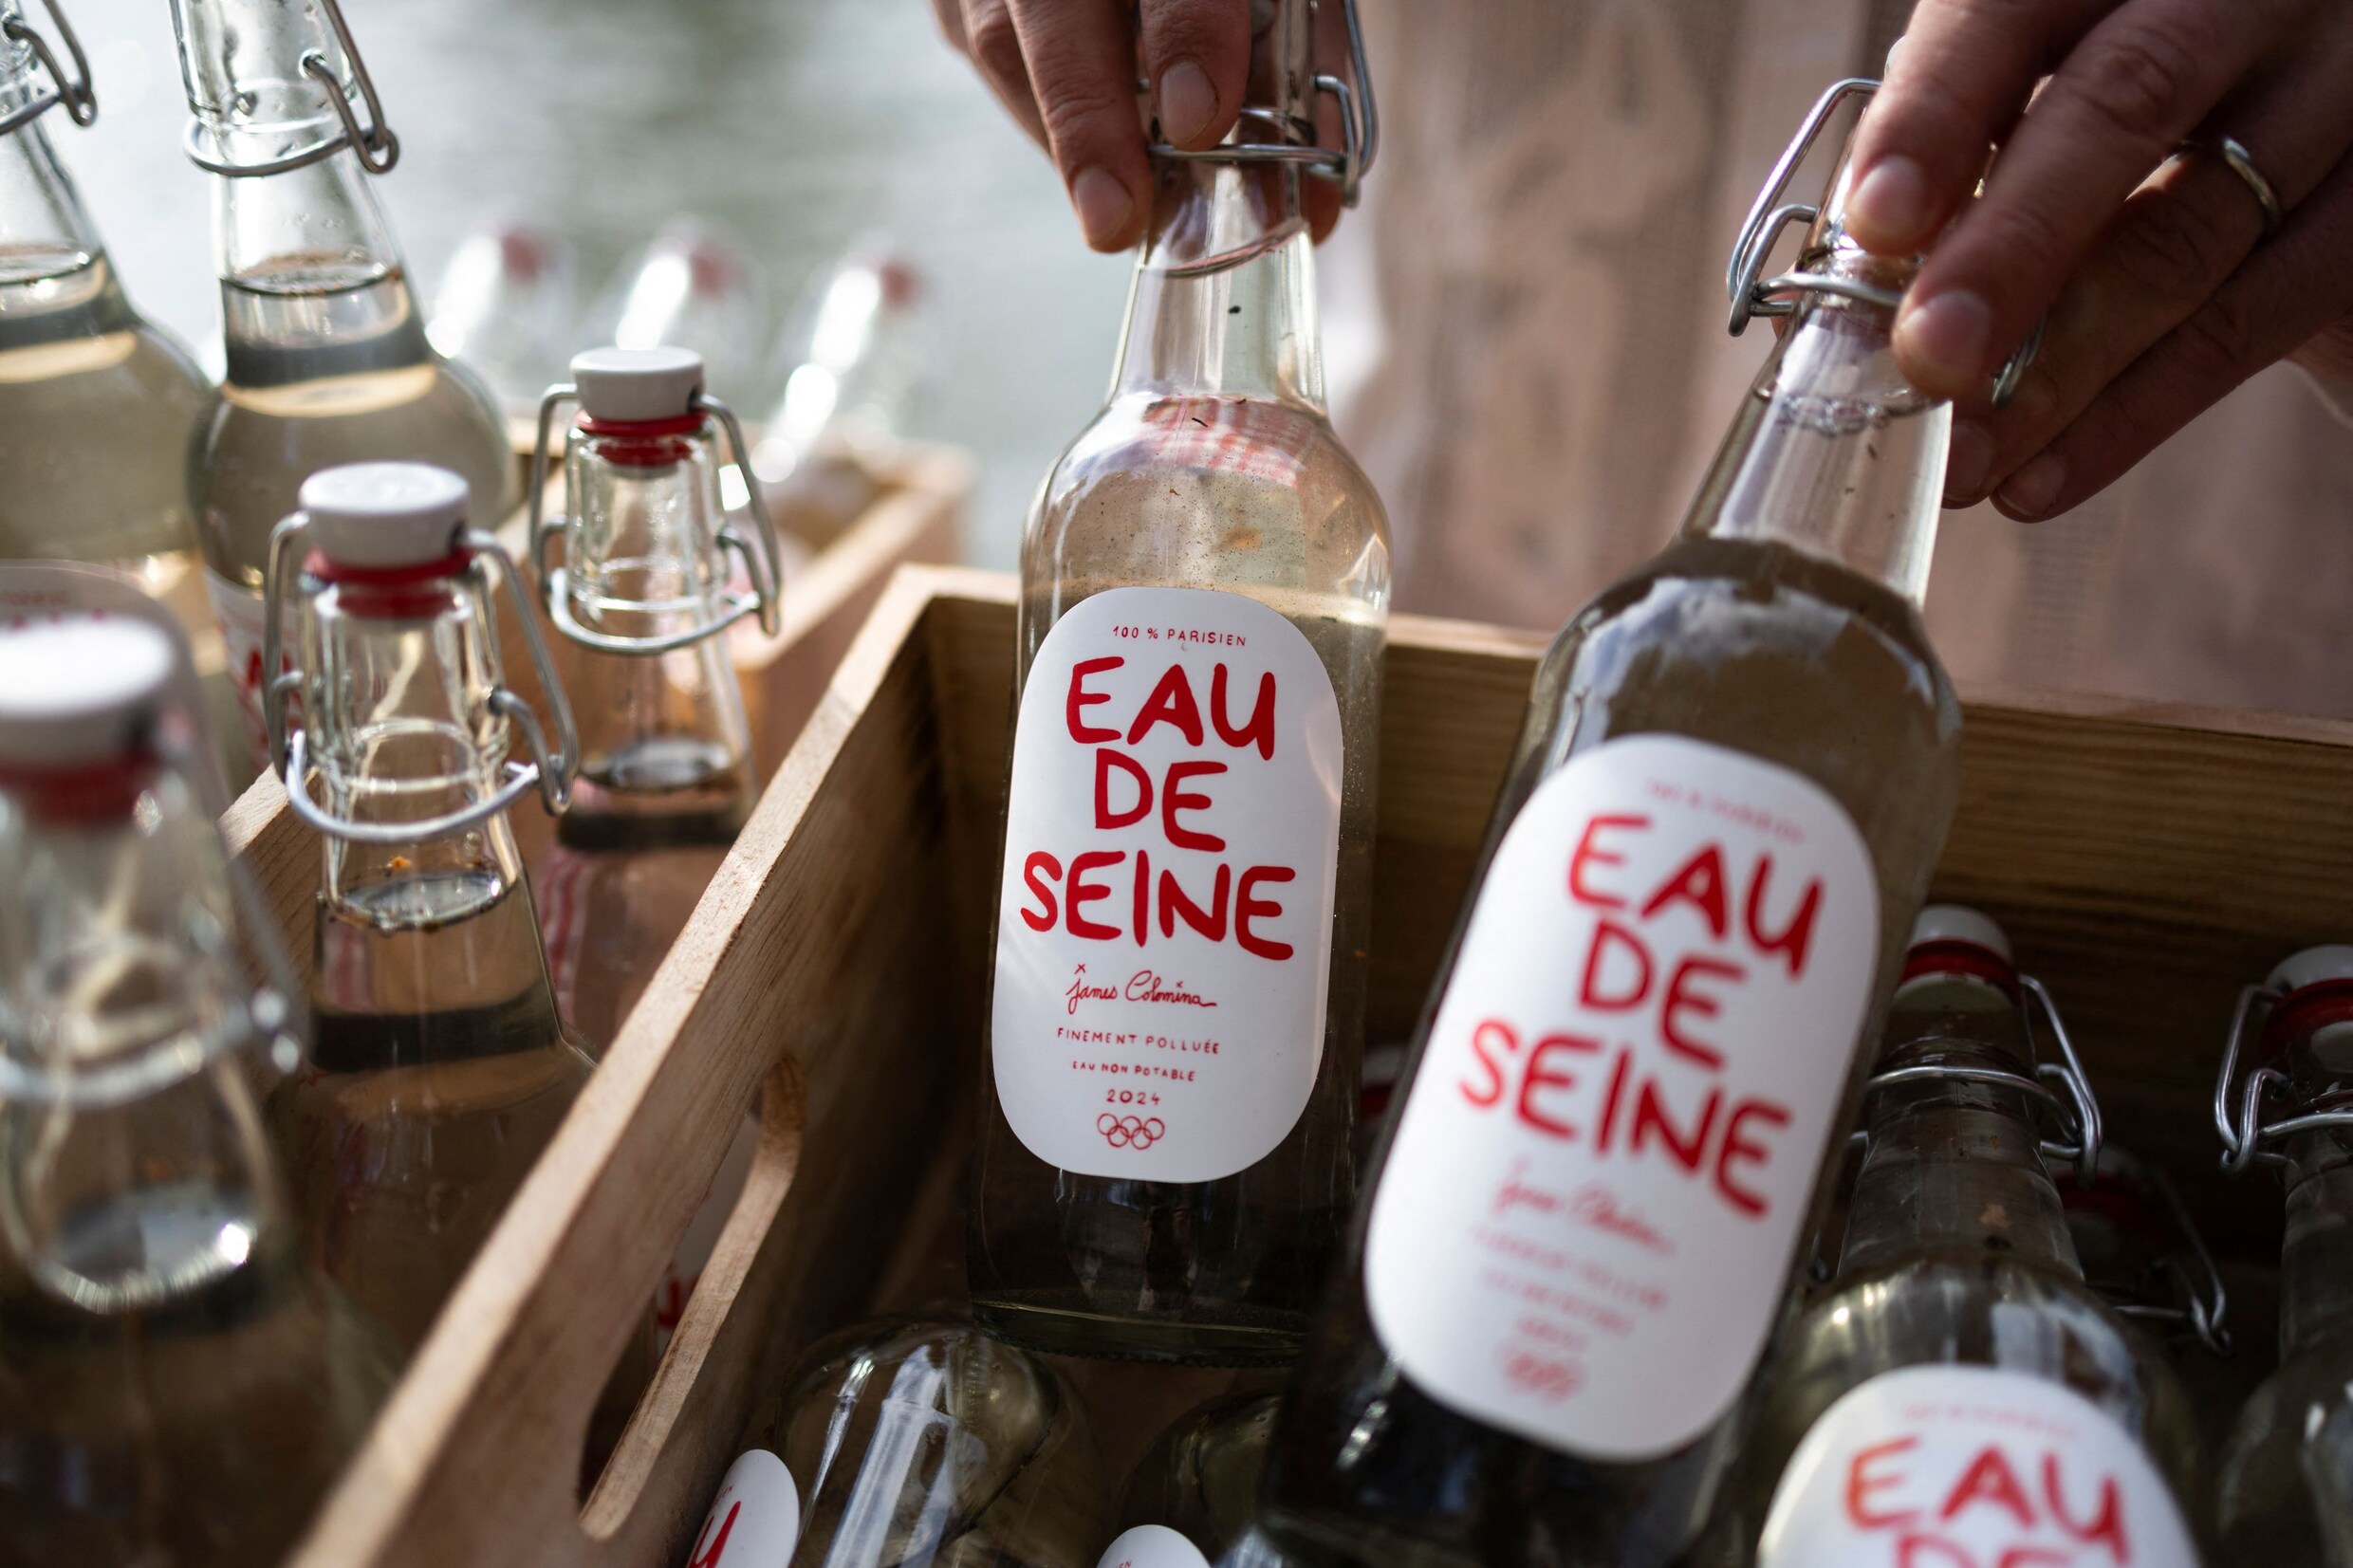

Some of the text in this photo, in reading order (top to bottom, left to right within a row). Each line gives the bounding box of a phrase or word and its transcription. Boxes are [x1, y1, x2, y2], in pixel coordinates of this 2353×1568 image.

[1112, 624, 1247, 647] 100 % PARISIEN
[1065, 655, 1276, 761] EAU
[1094, 747, 1229, 853] DE
[1019, 849, 1296, 961] SEINE
[1566, 812, 1825, 981] EAU
[1056, 1026, 1220, 1055] FINEMENT POLLUÉE
[1577, 914, 1746, 1074] DE
[1071, 1060, 1196, 1082] EAU NON POTABLE
[1106, 1088, 1161, 1106] 2024
[1458, 1018, 1792, 1219] SEINE
[1843, 1436, 2130, 1565] EAU
